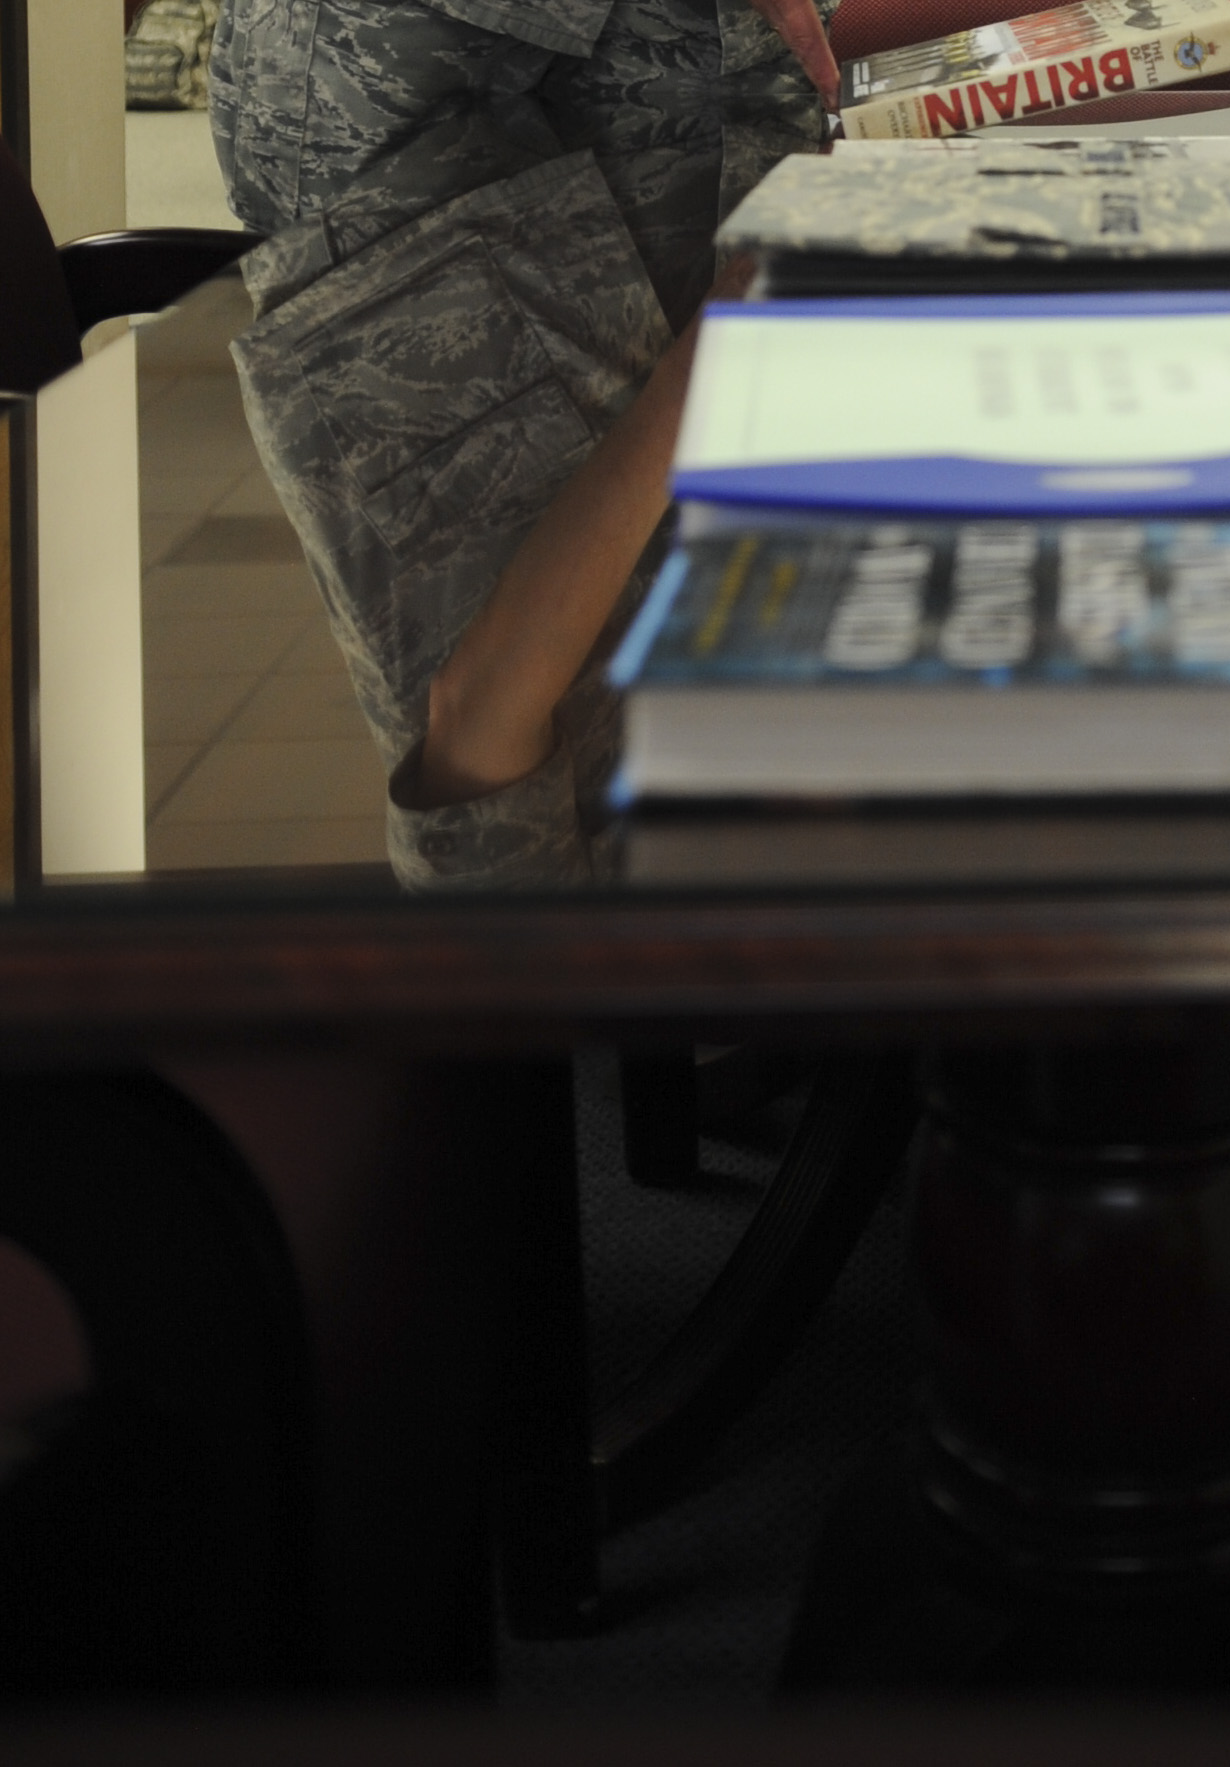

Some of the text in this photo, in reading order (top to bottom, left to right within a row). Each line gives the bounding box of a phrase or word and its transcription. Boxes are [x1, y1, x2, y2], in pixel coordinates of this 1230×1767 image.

[1130, 46, 1143, 63] OF
[1139, 43, 1160, 85] BATTLE
[1148, 39, 1164, 63] THE
[923, 47, 1136, 138] BRITAIN
